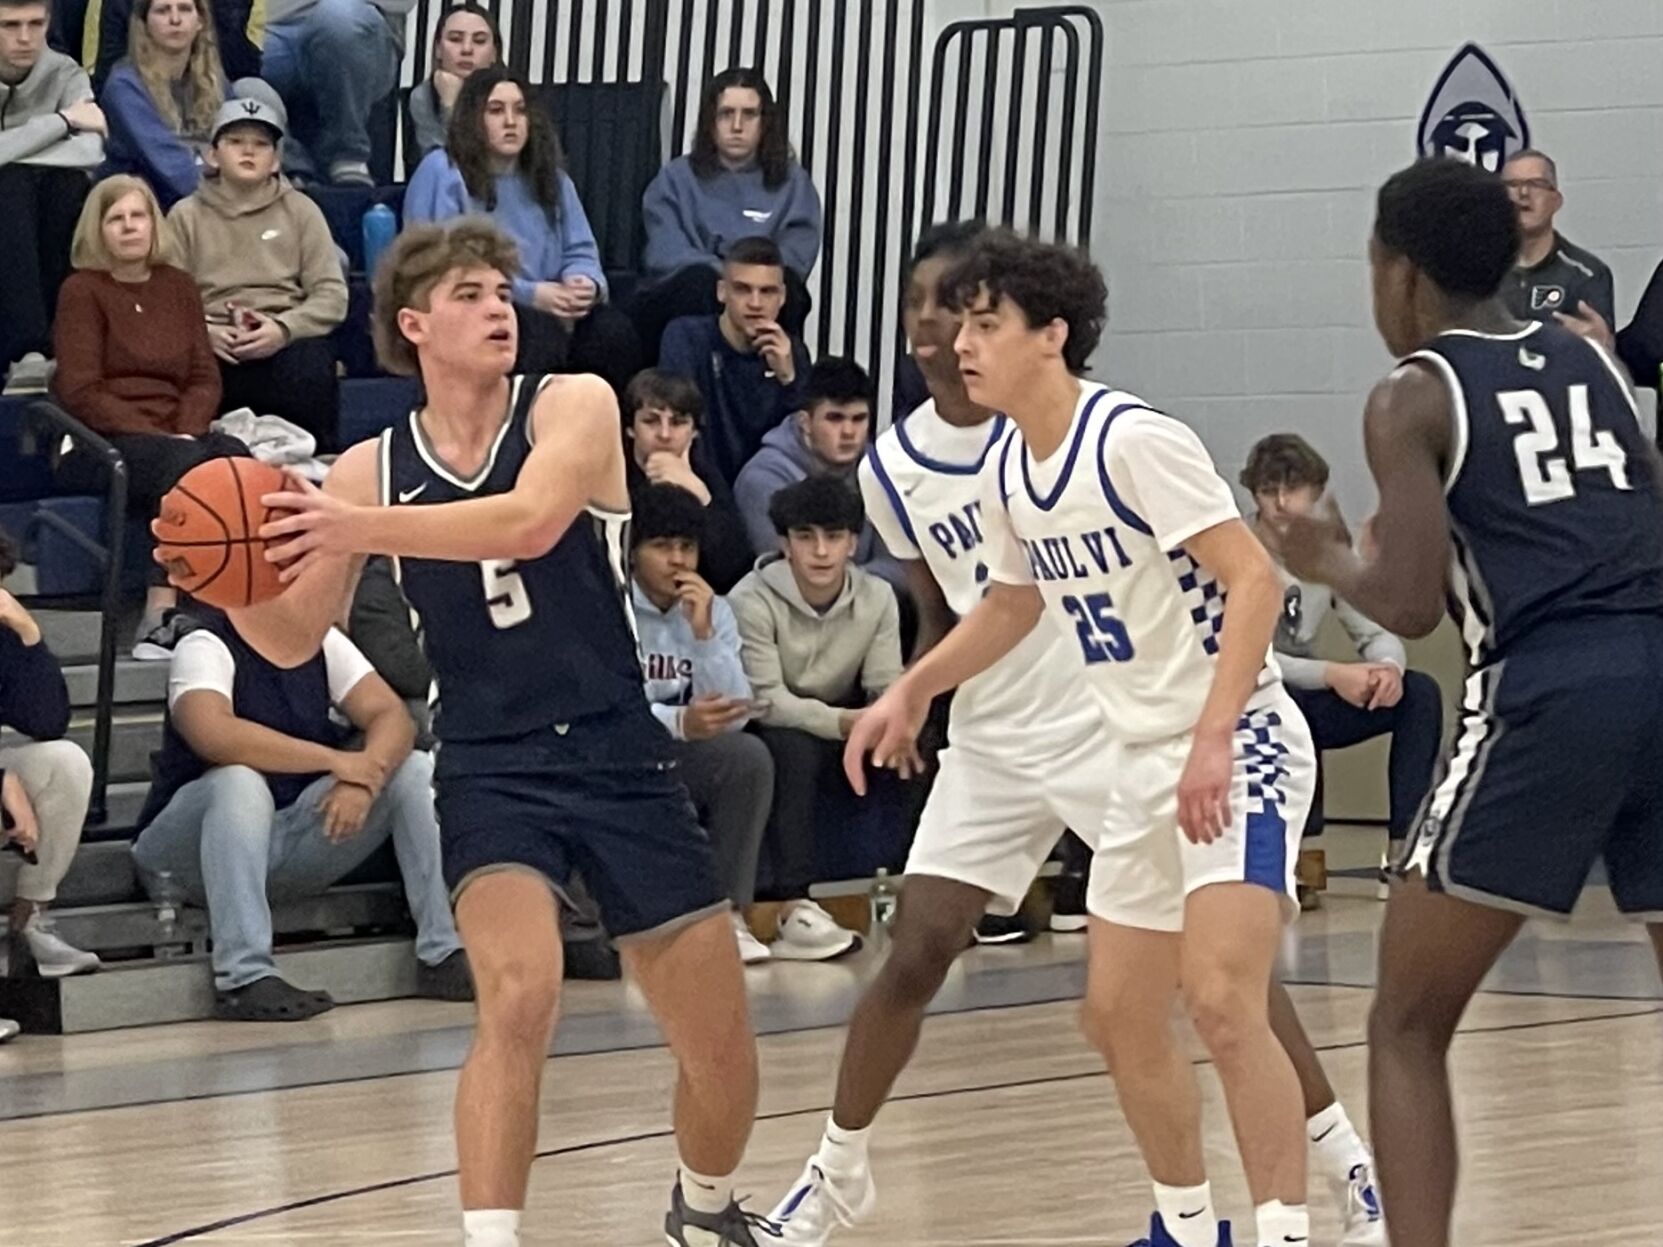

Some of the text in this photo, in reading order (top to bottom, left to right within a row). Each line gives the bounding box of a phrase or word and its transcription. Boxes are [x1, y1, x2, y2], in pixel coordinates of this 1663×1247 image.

[1495, 384, 1634, 507] 24
[1021, 535, 1089, 581] AUL
[1080, 526, 1133, 575] VI
[480, 559, 532, 629] 5
[1061, 592, 1136, 666] 25
